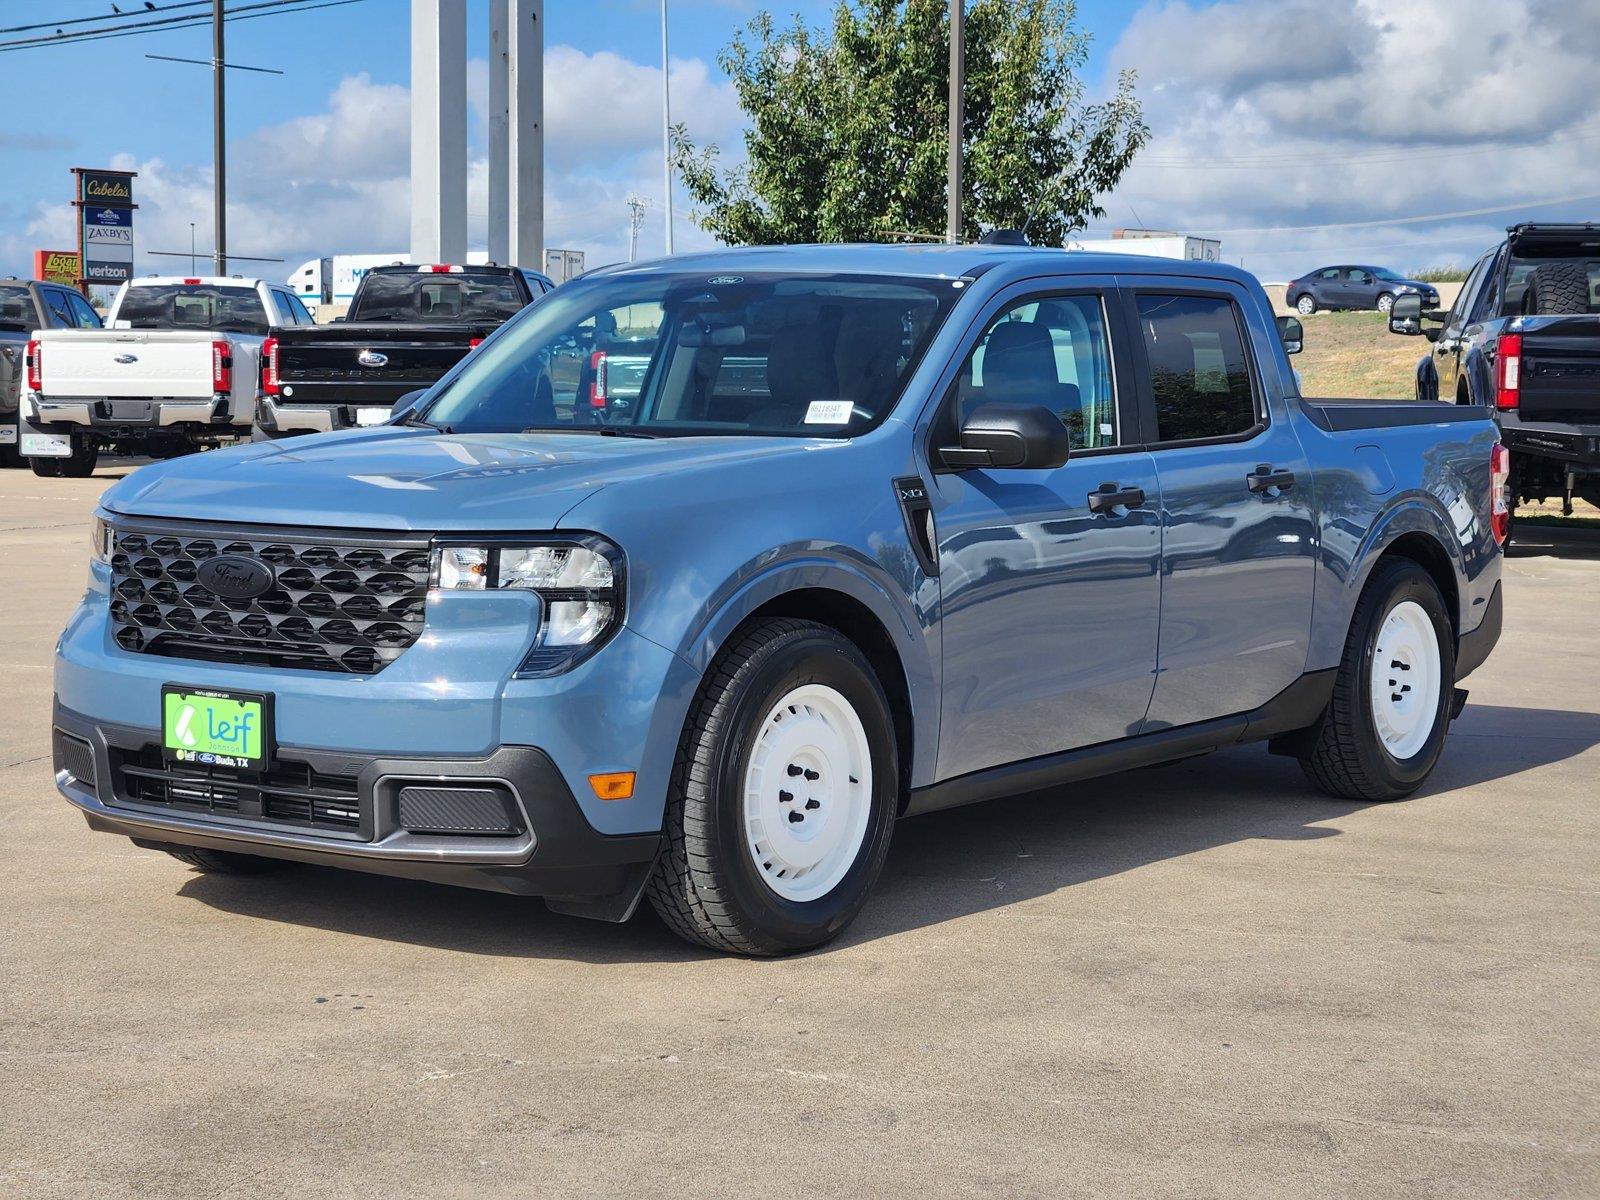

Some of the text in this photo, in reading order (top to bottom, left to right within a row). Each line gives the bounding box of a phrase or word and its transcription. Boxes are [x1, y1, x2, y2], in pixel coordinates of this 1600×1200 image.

[87, 180, 129, 197] Cabela's
[88, 228, 130, 241] ZAXBY'S
[88, 265, 127, 278] verizon
[207, 708, 254, 753] leif
[208, 742, 240, 752] Johnson
[216, 755, 236, 767] Buda,
[237, 757, 249, 767] TX
